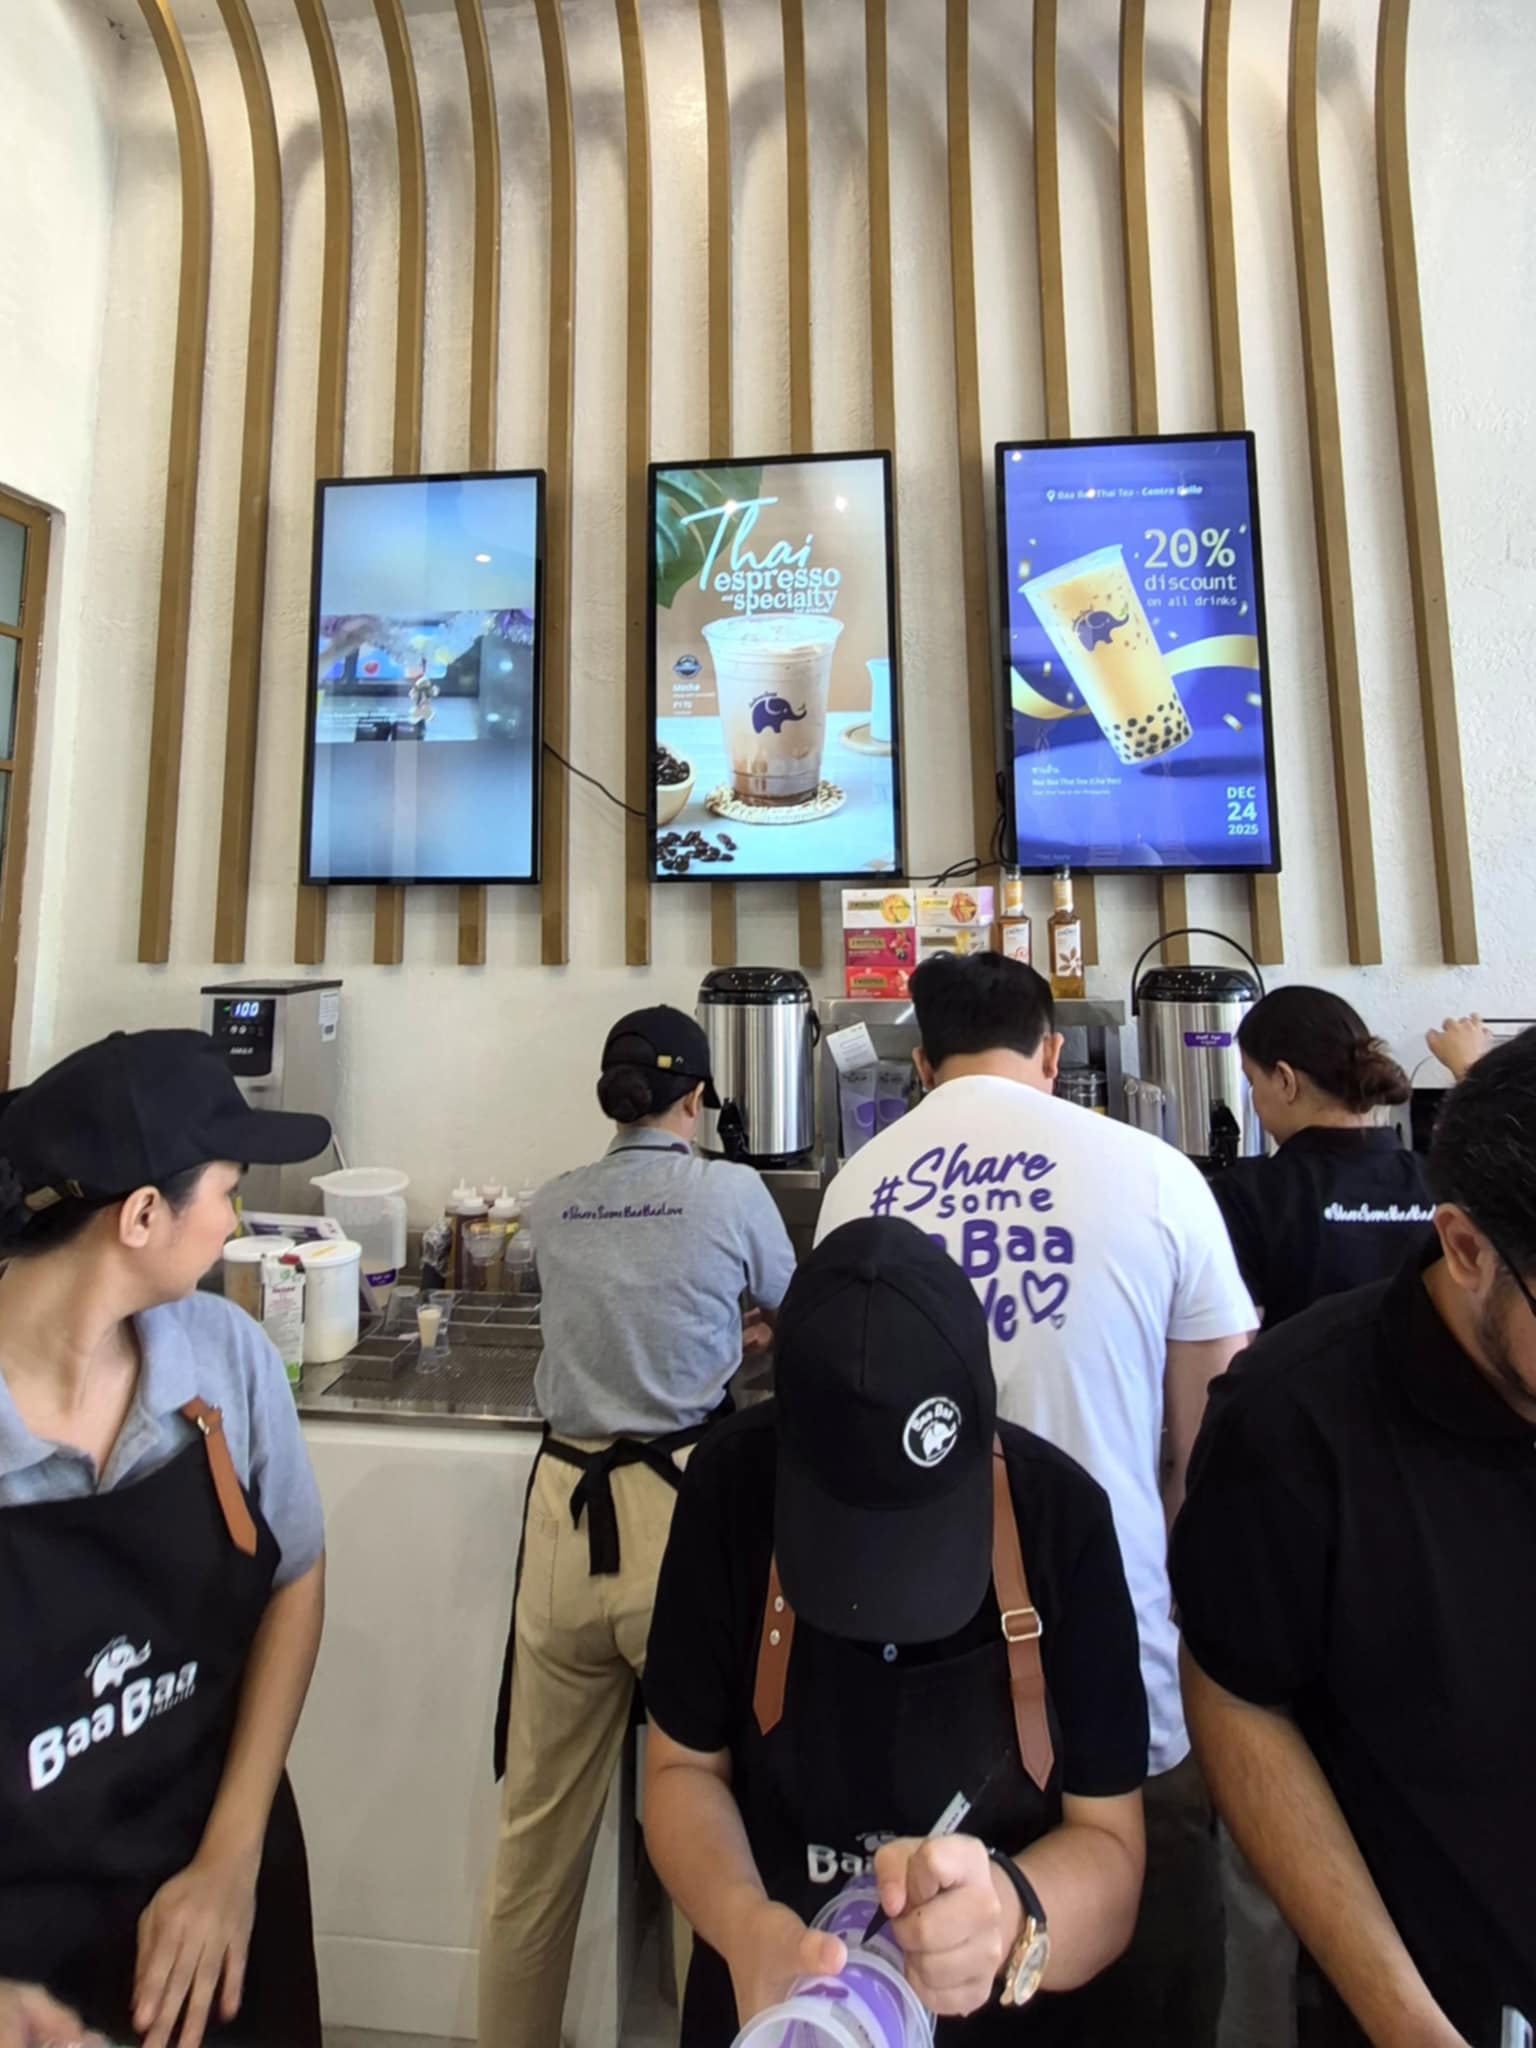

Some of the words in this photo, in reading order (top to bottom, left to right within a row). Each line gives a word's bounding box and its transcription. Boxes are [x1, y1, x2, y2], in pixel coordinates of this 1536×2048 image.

[680, 497, 815, 591] Thai
[1143, 527, 1237, 569] 20%
[714, 566, 842, 598] espresso
[1144, 573, 1238, 592] discount
[733, 586, 839, 615] specialty
[1146, 597, 1163, 607] on
[1167, 594, 1188, 607] all
[1194, 594, 1238, 607] drinks
[1227, 786, 1256, 799] DEC
[1227, 801, 1258, 821] 24
[1228, 824, 1259, 835] 2025
[234, 1001, 260, 1017] 100
[936, 1188, 1054, 1219] some
